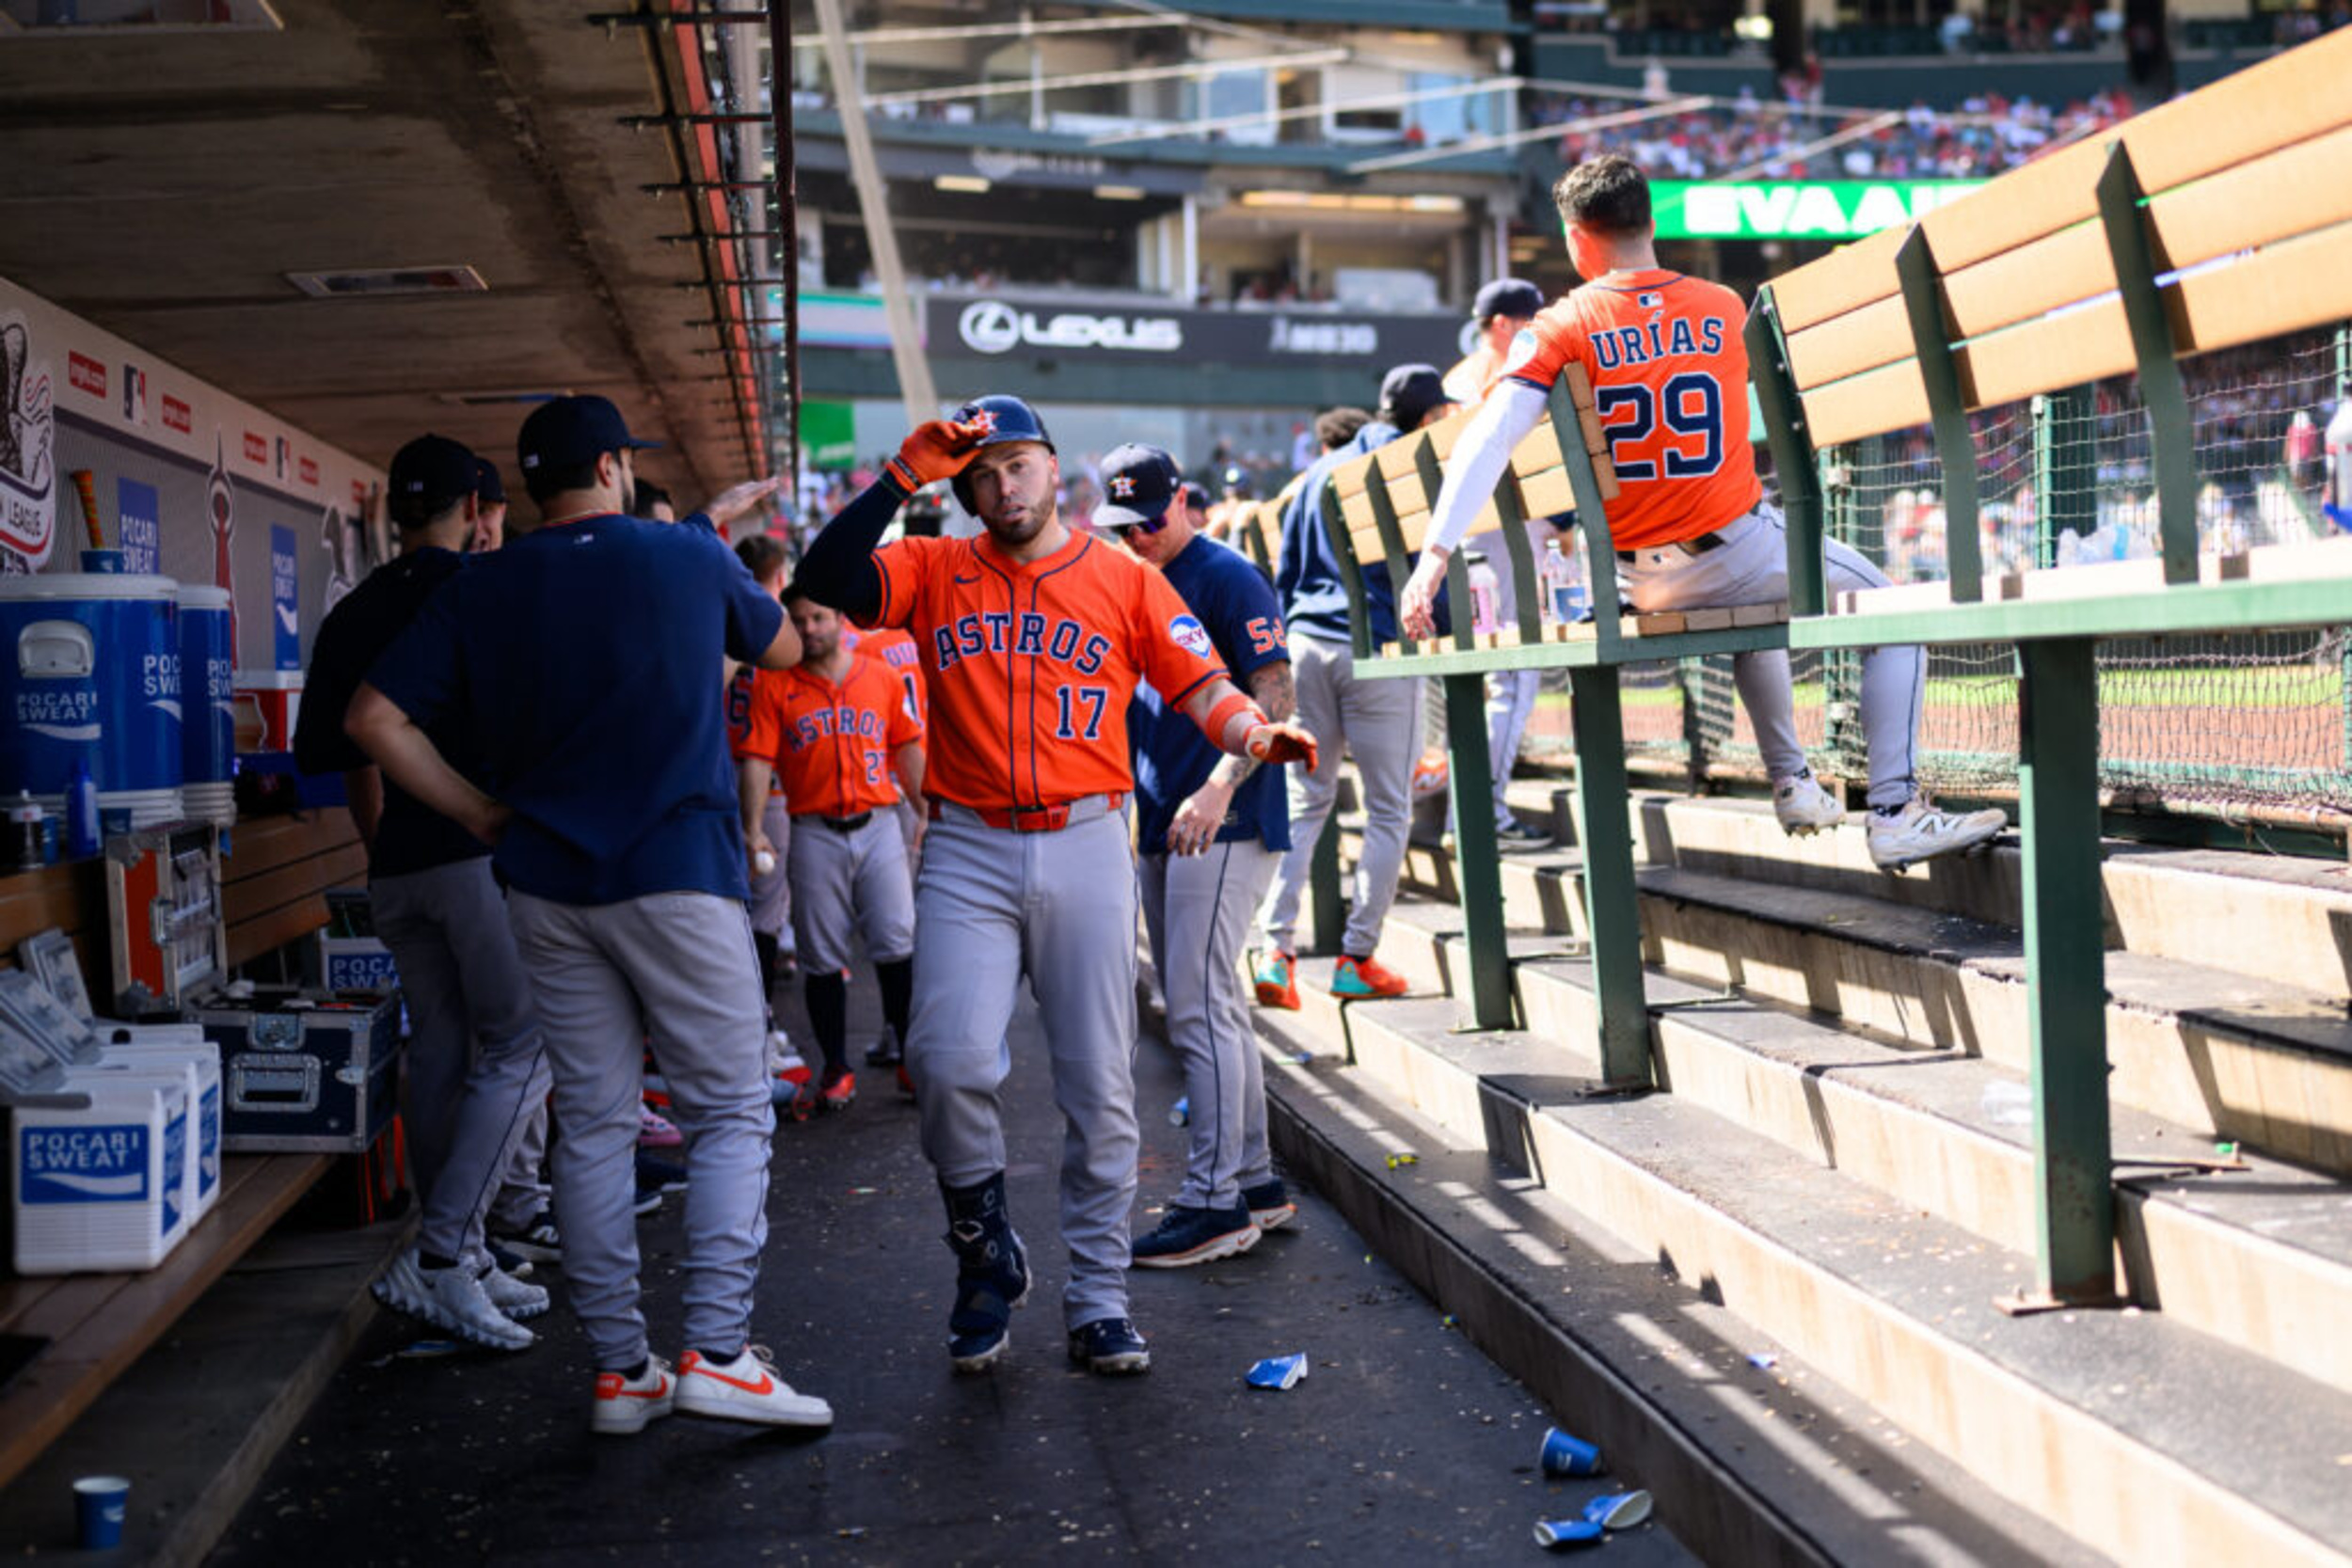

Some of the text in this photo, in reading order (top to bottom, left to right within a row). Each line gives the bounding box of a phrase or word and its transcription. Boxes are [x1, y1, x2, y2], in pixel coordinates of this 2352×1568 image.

[1021, 312, 1182, 351] LEXUS
[1589, 309, 1724, 369] URÍAS
[1595, 371, 1724, 481] 29
[120, 515, 158, 548] POCARI
[934, 611, 1112, 675] ASTROS
[207, 659, 232, 677] PO
[17, 692, 98, 707] POCARI
[17, 706, 89, 721] SWEAT
[1056, 684, 1107, 740] 17
[785, 707, 887, 753] ASTROS
[28, 1132, 139, 1150] POCARI
[28, 1149, 129, 1169] SWEAT
